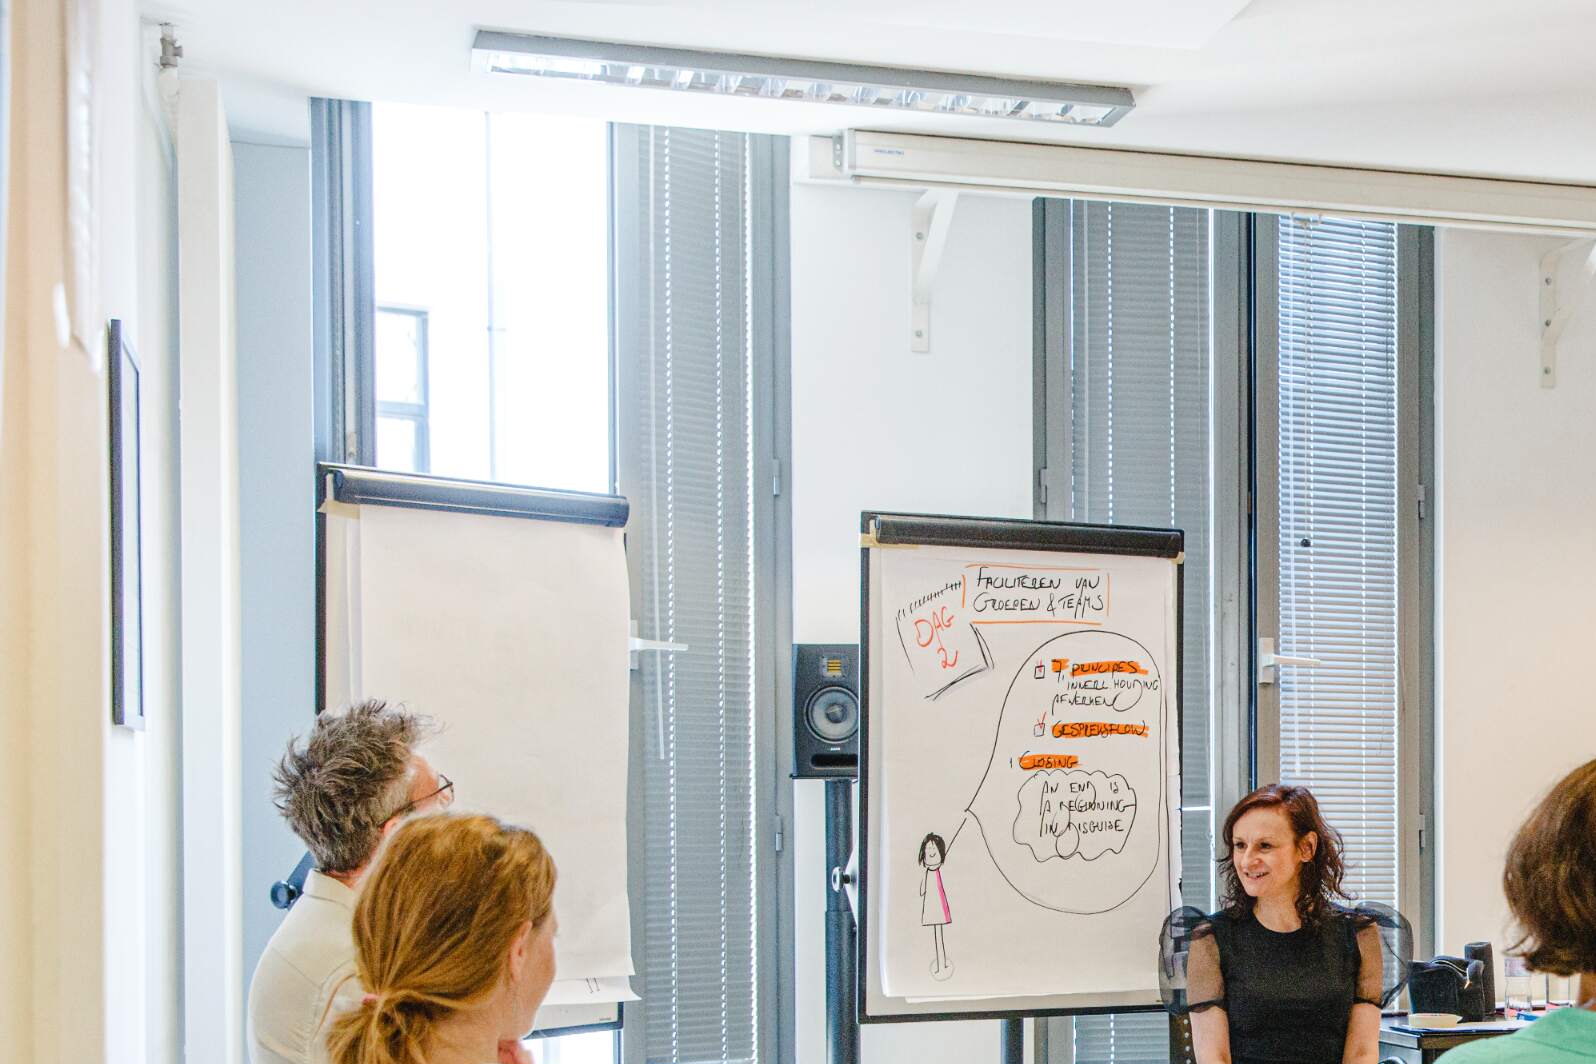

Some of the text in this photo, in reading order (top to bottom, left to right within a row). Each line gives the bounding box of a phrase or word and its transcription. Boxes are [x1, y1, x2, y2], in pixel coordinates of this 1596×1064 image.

[1075, 576, 1100, 594] VAN
[973, 592, 1104, 618] GROEPEN & TEAMS
[914, 605, 955, 647] DAG
[937, 647, 959, 669] 2
[1071, 660, 1138, 679] PRINCIPES
[1113, 680, 1160, 698] HOUDING
[1019, 750, 1080, 770] CLOSING
[1069, 780, 1097, 801] END
[1110, 781, 1119, 794] IS
[1045, 821, 1059, 835] IN
